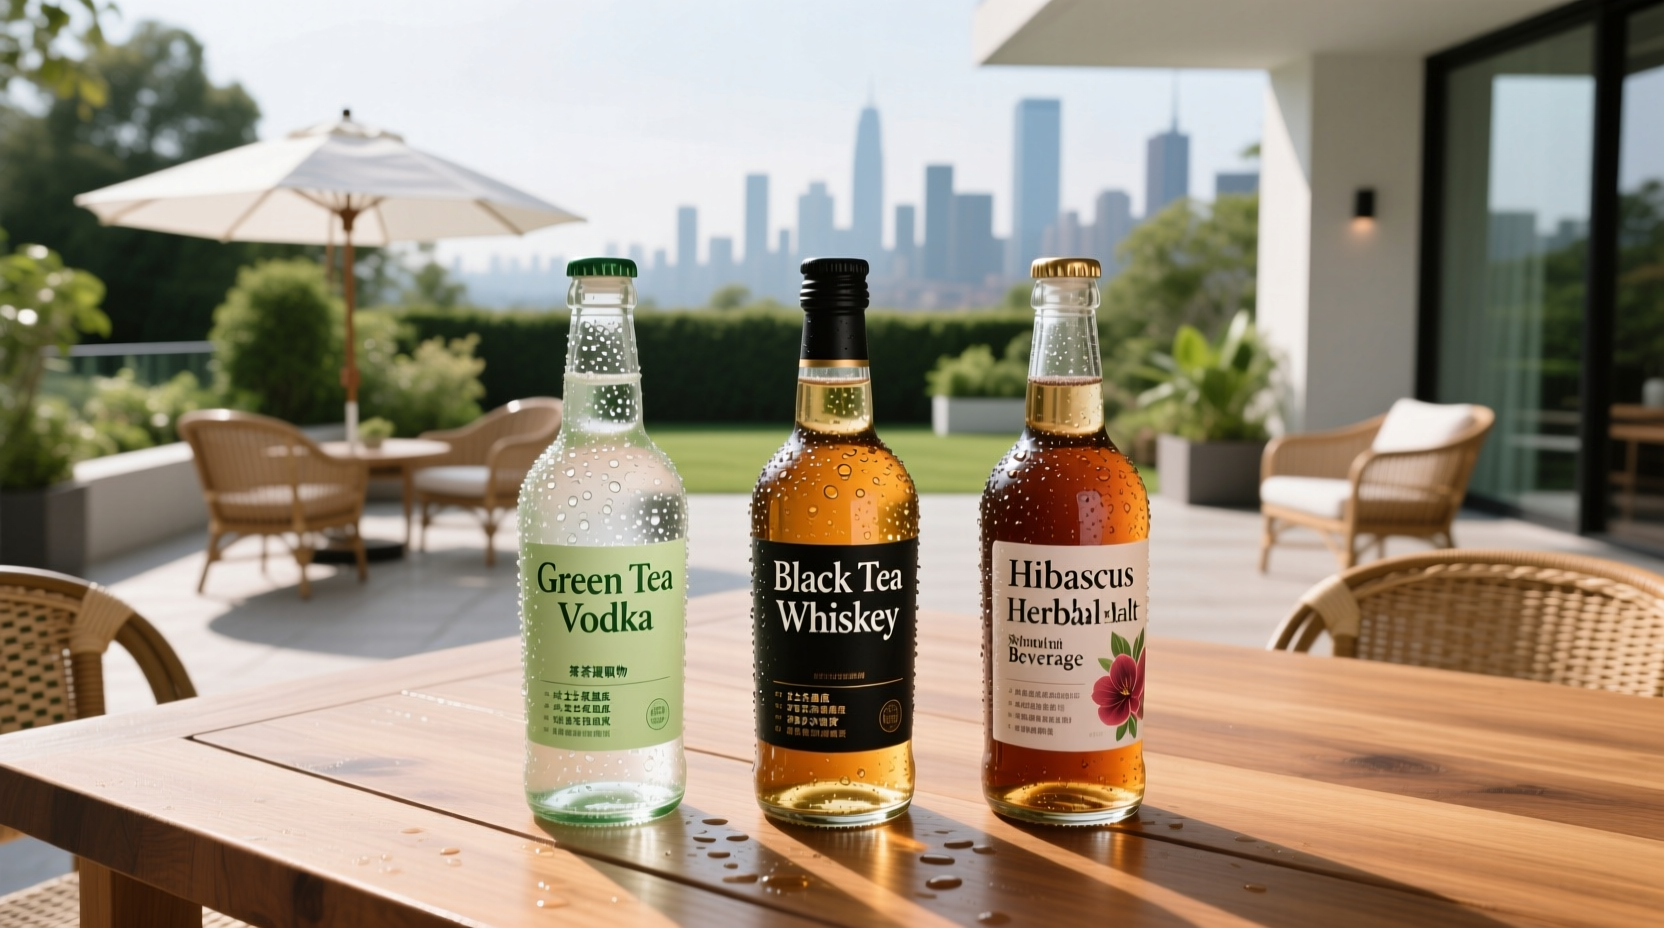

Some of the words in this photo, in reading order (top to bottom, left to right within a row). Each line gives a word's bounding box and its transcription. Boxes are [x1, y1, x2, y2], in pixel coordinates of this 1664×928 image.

[537, 561, 623, 595] Green
[628, 562, 674, 594] Tea
[773, 559, 854, 594] Black
[857, 560, 903, 593] Tea
[1008, 558, 1134, 590] Hibascus
[557, 600, 654, 634] Vodka
[775, 599, 900, 641] Whiskey
